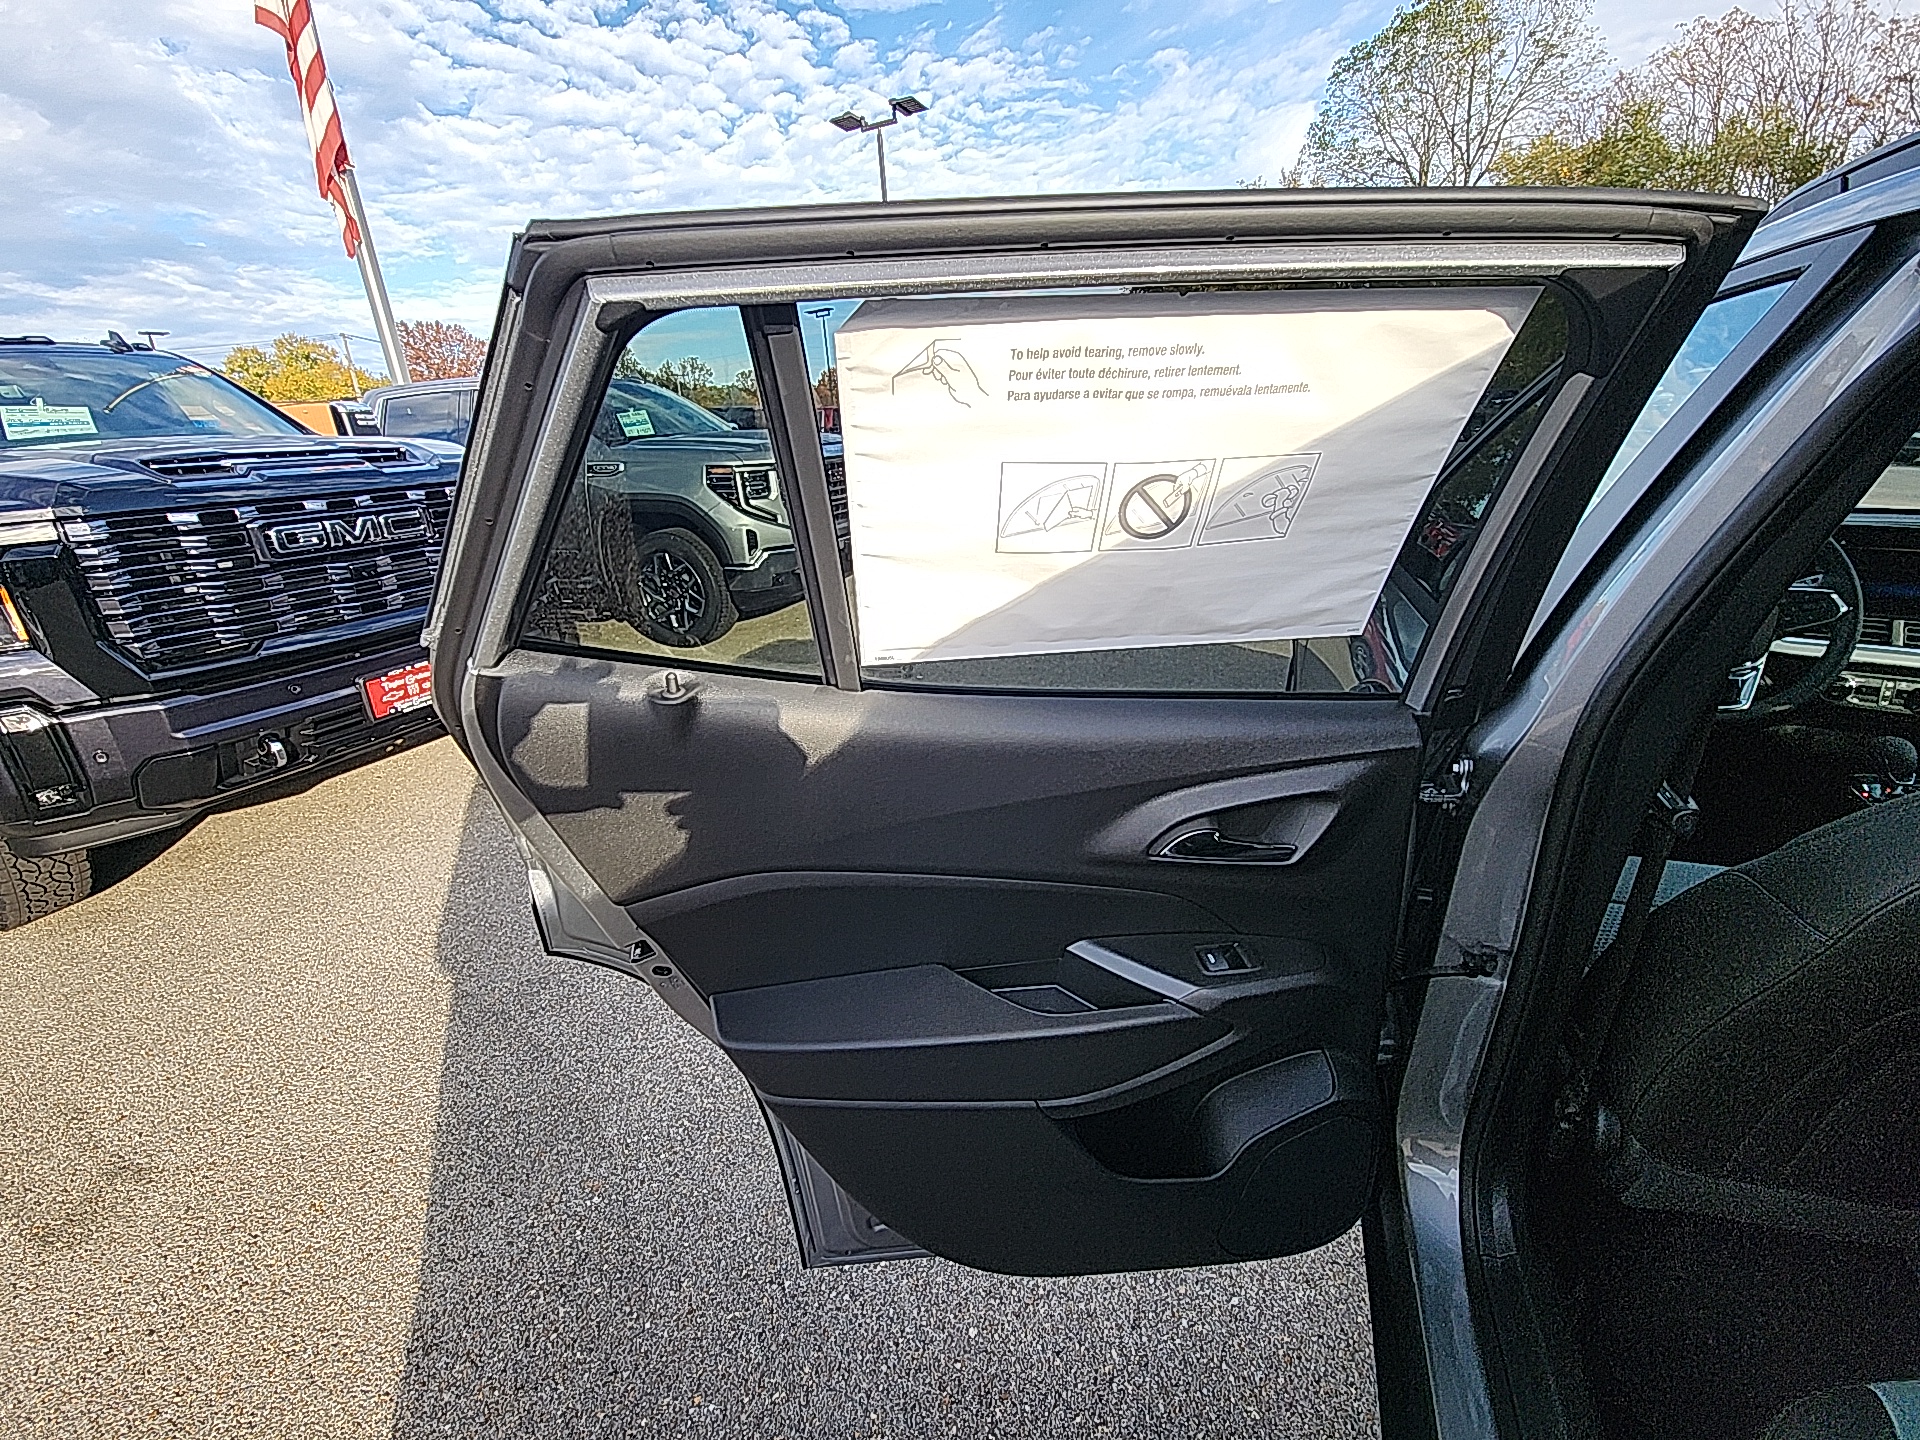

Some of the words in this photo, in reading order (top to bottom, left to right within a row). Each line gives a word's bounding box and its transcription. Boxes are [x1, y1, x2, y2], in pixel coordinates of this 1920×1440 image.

[1010, 347, 1024, 361] To
[1026, 347, 1050, 362] help
[1052, 345, 1082, 359] avoid
[1084, 345, 1125, 361] tearing,
[1127, 346, 1167, 358] remove
[1169, 342, 1205, 358] slowly.
[1008, 369, 1034, 382] Pour
[1035, 367, 1067, 381] éviter
[1068, 367, 1096, 380] toute
[1097, 366, 1151, 381] déchirure,
[1153, 365, 1187, 378] retirer
[1187, 363, 1242, 377] lentement.
[1006, 390, 1031, 402] Para
[1033, 388, 1081, 403] ayudarse
[1082, 389, 1090, 400] a
[1092, 387, 1124, 400] evitar
[1124, 390, 1145, 402] que
[1146, 389, 1160, 400] se
[1161, 388, 1197, 401] rompa,
[1199, 384, 1253, 398] remuévala
[1253, 381, 1311, 396] lentamente.
[271, 510, 425, 553] GMC
